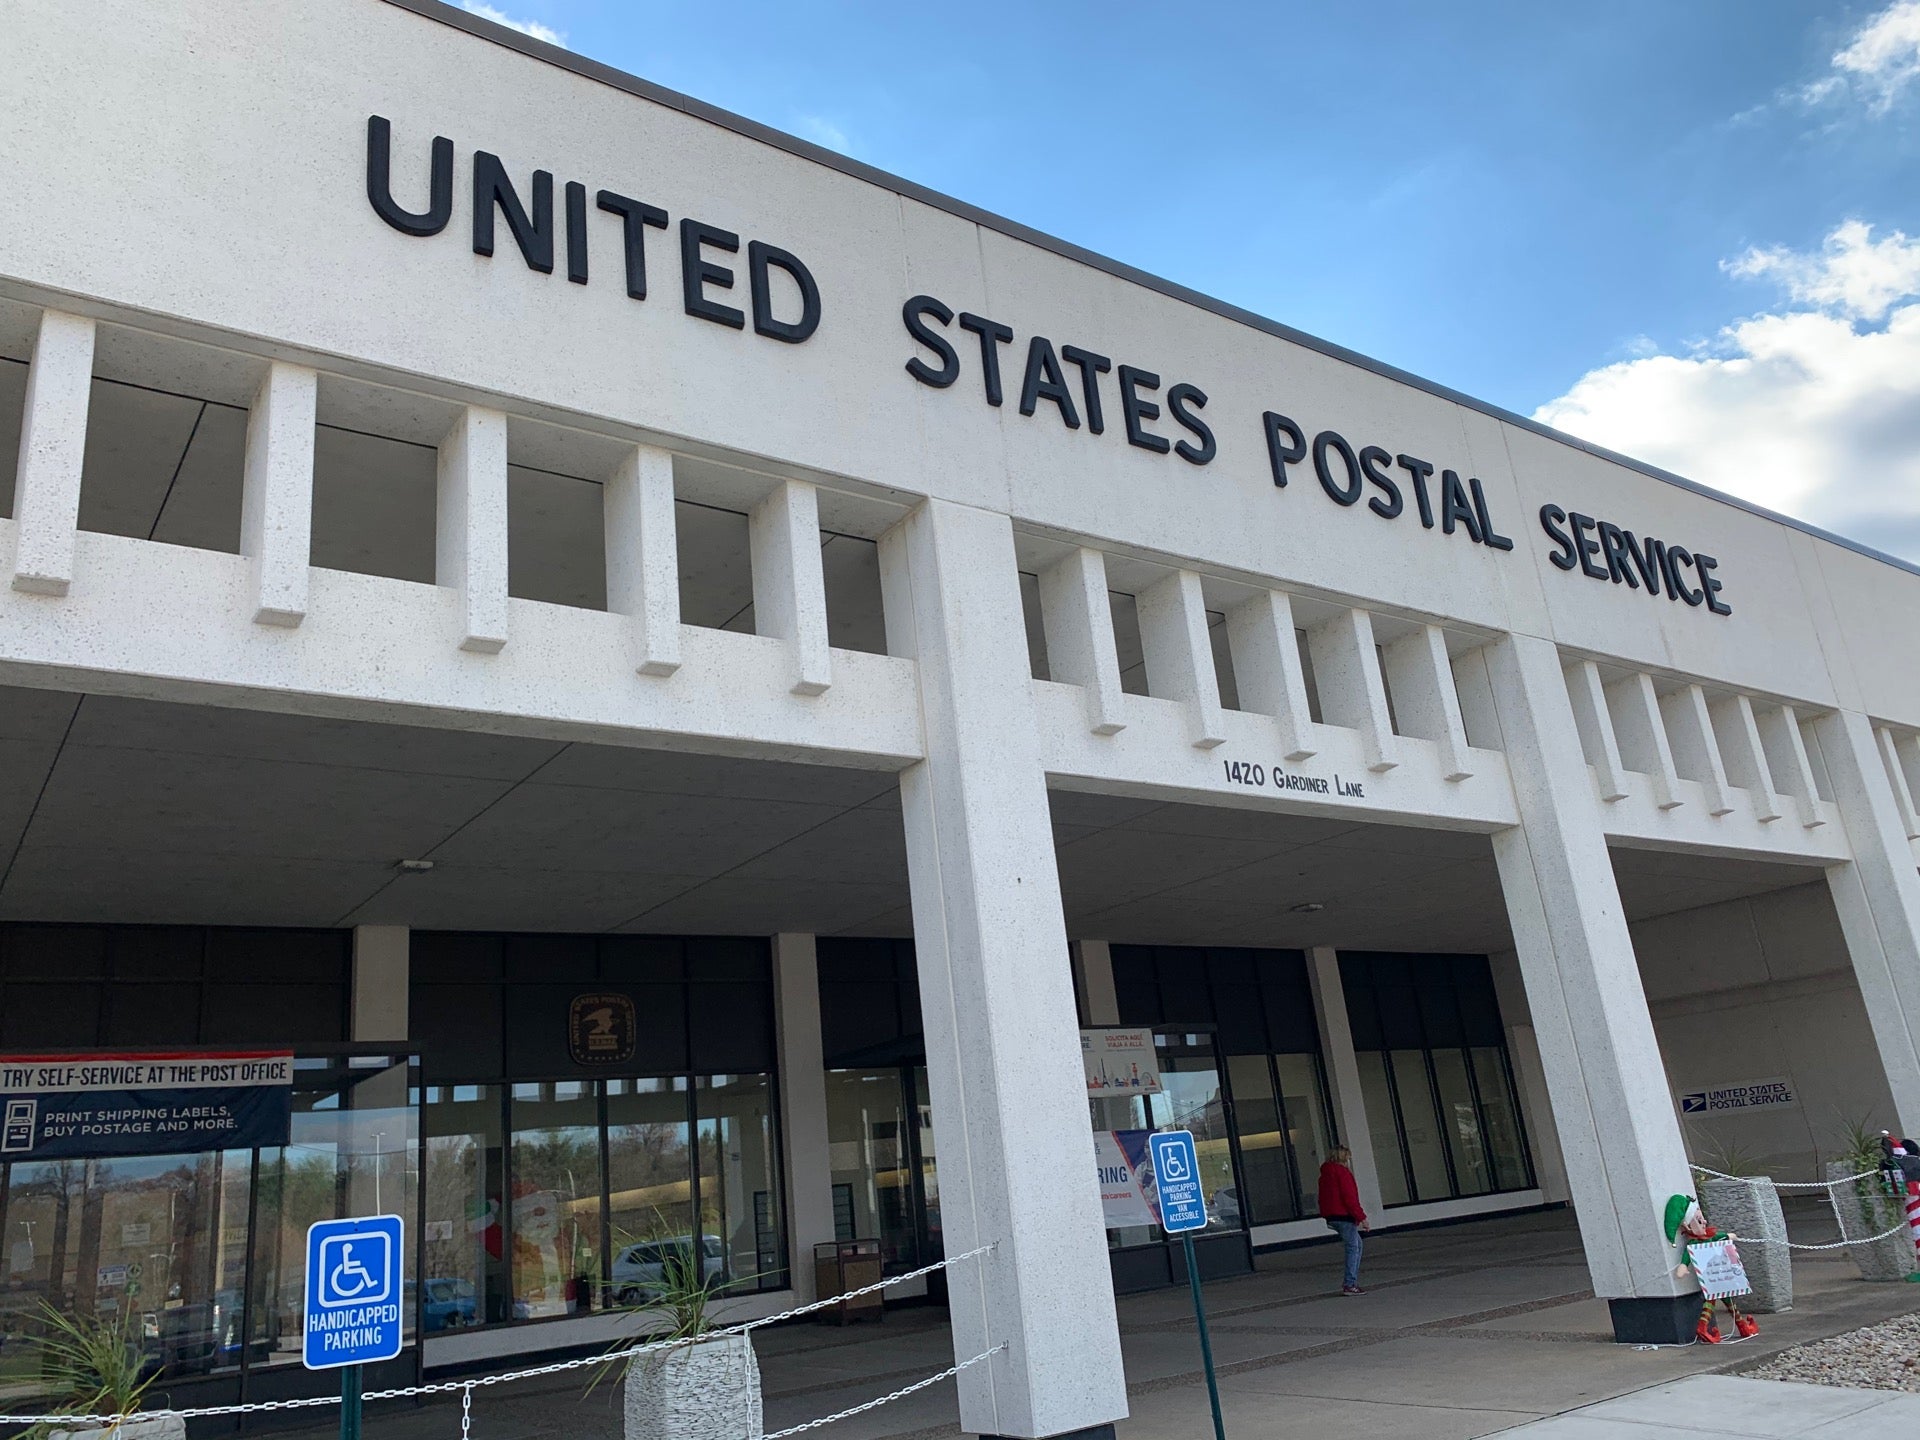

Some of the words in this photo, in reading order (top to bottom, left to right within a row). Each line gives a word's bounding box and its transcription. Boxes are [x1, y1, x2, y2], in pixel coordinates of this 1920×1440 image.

[367, 115, 821, 344] UNITED
[902, 295, 1217, 465] STATES
[1263, 411, 1513, 551] POSTAL
[1540, 504, 1732, 616] SERVICE
[1224, 760, 1265, 786] 1420
[3, 1069, 34, 1088] TRY
[37, 1066, 143, 1087] SELF-SERVICE
[147, 1066, 163, 1084] AT
[169, 1064, 196, 1084] THE
[201, 1063, 239, 1082] POST
[241, 1062, 287, 1080] OFFICE
[1708, 1087, 1747, 1101] UNITED
[1749, 1083, 1786, 1096] STATES
[1709, 1098, 1748, 1110] POSTAL
[1750, 1091, 1792, 1106] SERVICE
[45, 1111, 92, 1124] PRINT
[97, 1108, 167, 1121] SHIPPING
[172, 1106, 231, 1119] LABELS,
[44, 1126, 77, 1137] BUY
[81, 1122, 151, 1135] POSTAGE
[156, 1120, 189, 1131] AND
[193, 1118, 239, 1130] MORE.
[1162, 1182, 1197, 1194] HANDICAPPED
[1169, 1191, 1192, 1202] PARKING
[1169, 1210, 1200, 1223] ACCESSIBLE
[1177, 1203, 1188, 1212] VAN
[309, 1304, 398, 1332] HANDICAPPED
[324, 1326, 382, 1351] PARKING
